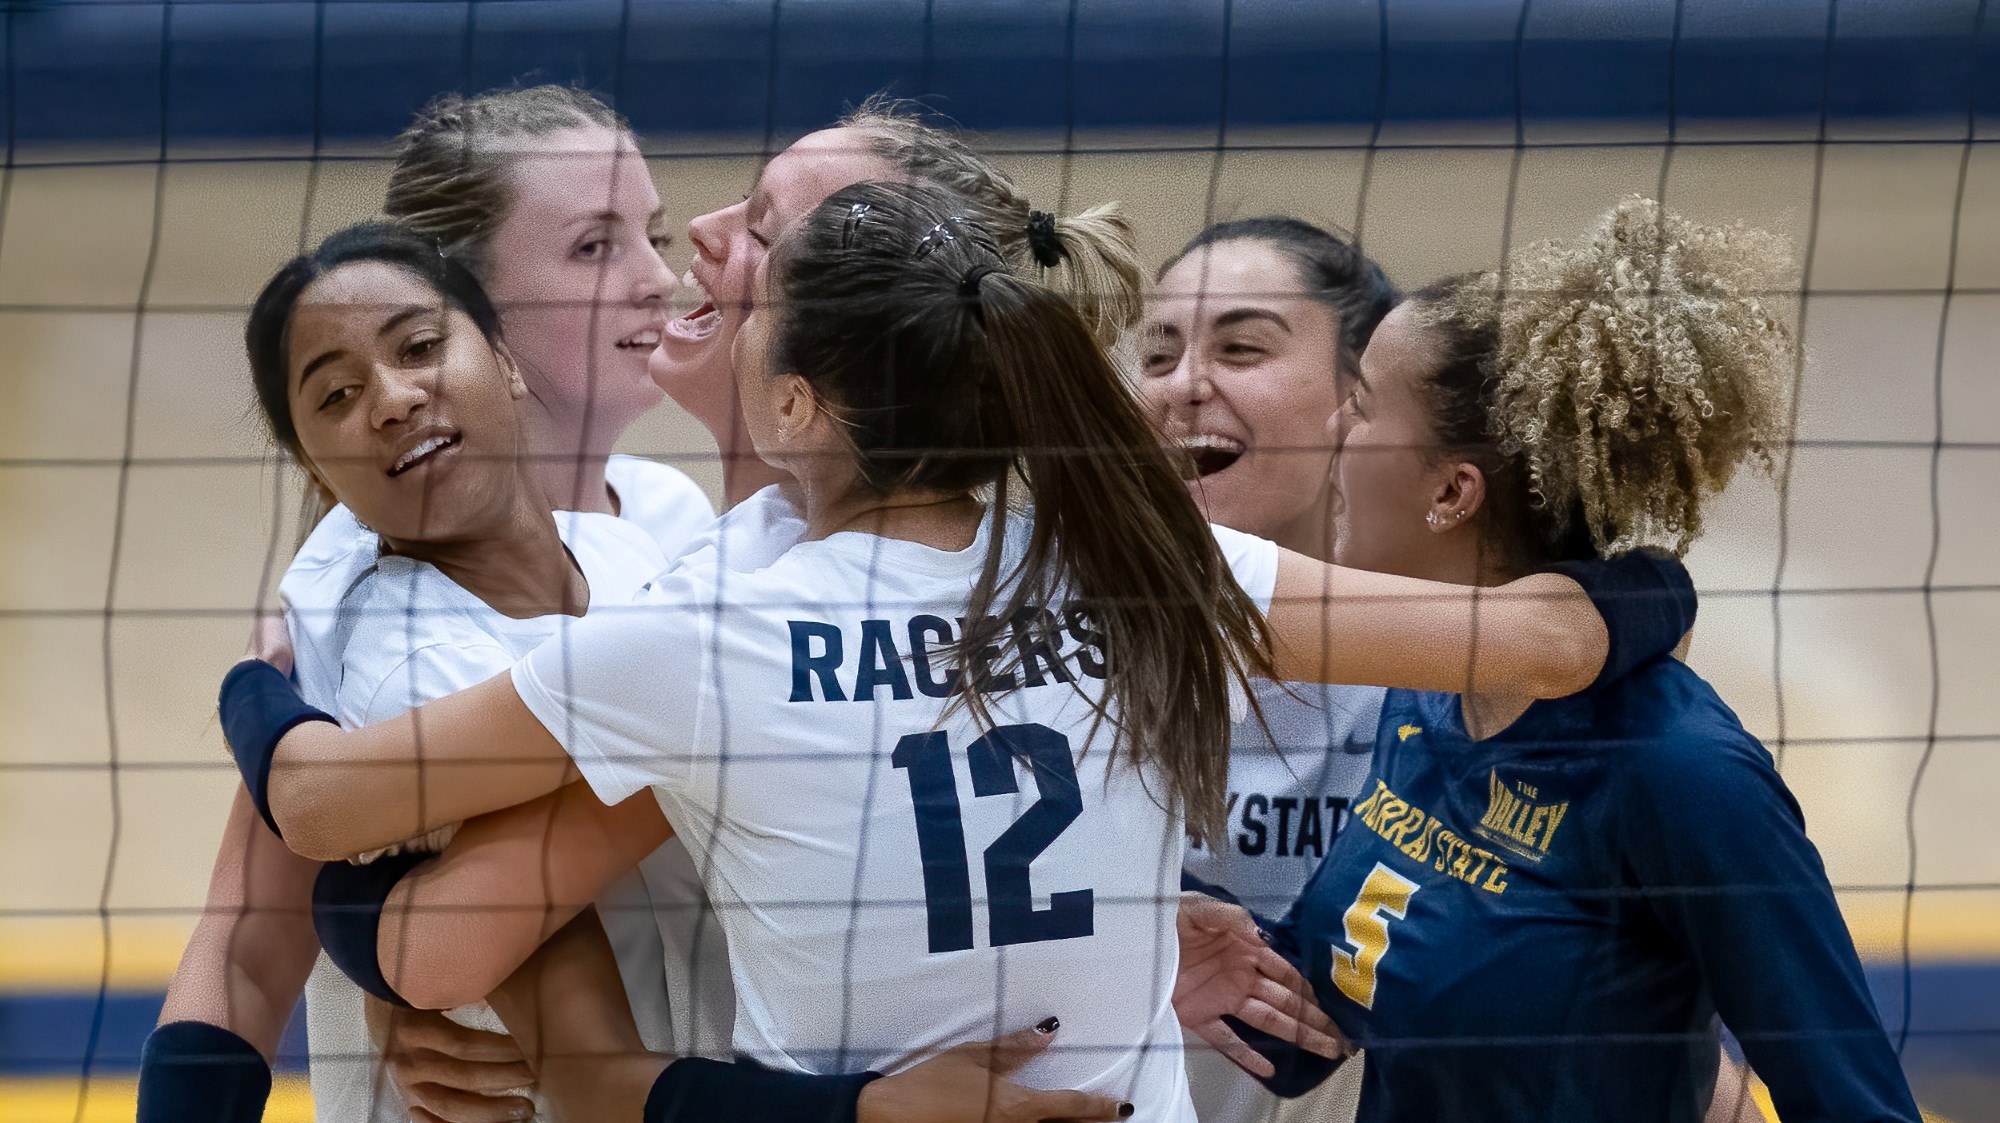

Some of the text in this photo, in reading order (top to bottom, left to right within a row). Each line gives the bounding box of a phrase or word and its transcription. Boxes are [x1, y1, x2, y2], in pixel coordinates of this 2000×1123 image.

[787, 602, 1112, 702] RACERS
[1237, 793, 1350, 858] STAT
[1480, 765, 1569, 854] VALLEY
[1516, 779, 1539, 799] THE
[891, 723, 1094, 953] 12
[1331, 861, 1421, 1011] 5
